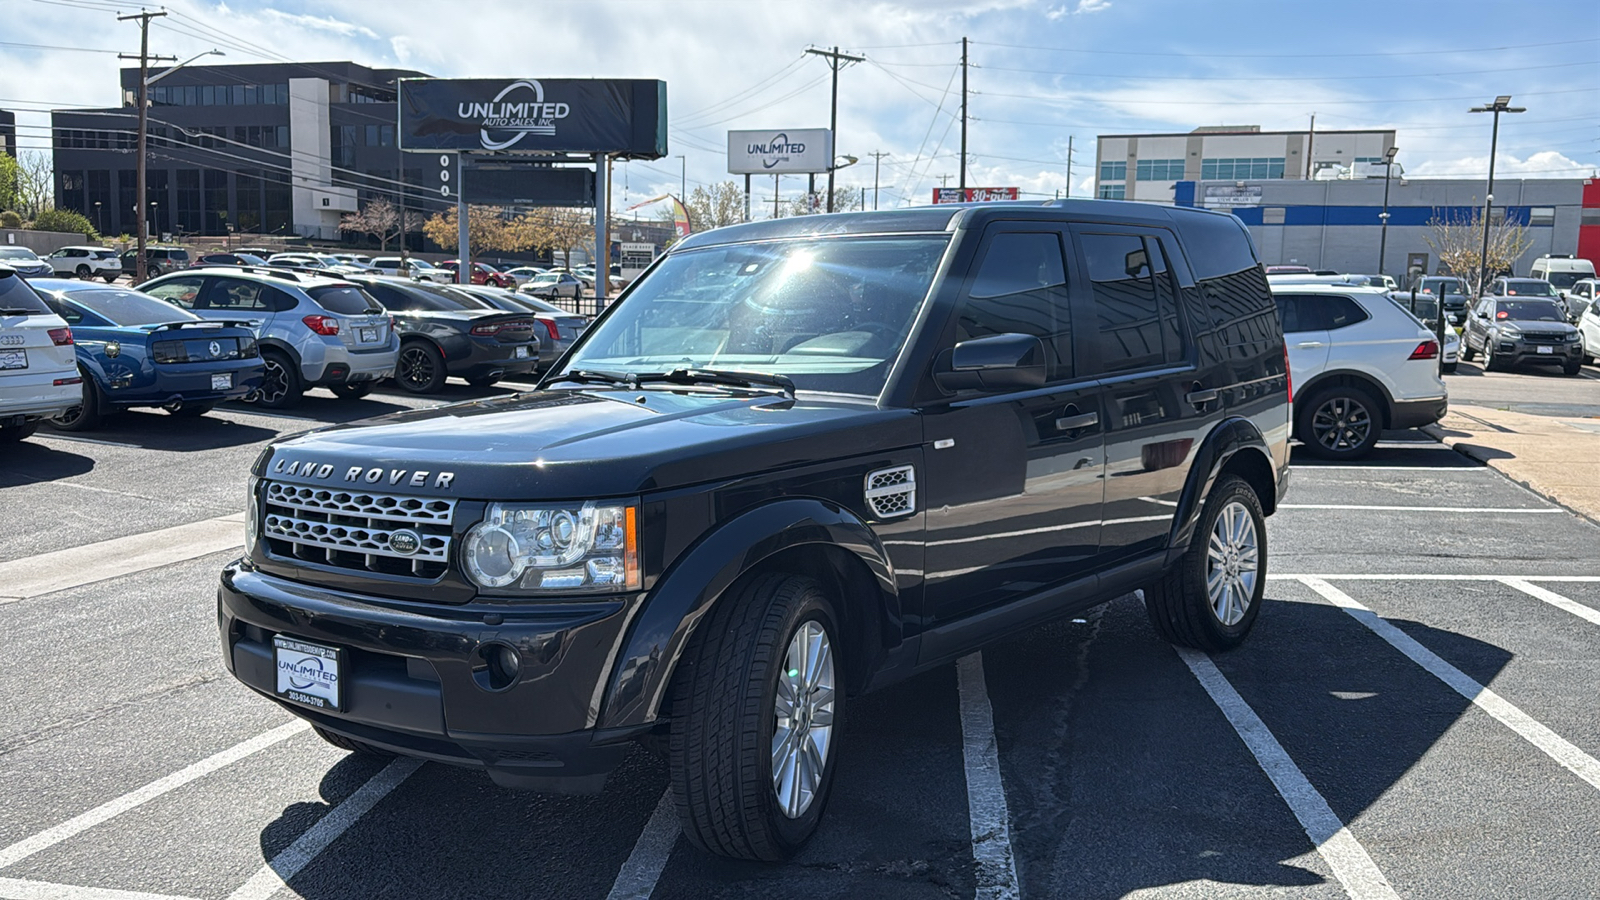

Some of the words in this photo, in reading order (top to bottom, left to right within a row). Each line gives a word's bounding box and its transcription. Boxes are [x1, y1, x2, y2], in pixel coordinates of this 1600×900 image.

[458, 102, 570, 119] UNLIMITED
[482, 118, 506, 126] AUTO
[747, 143, 806, 154] UNLIMITED
[273, 459, 335, 479] LAND
[344, 466, 456, 489] ROVER
[278, 660, 338, 682] UNLIMITED
